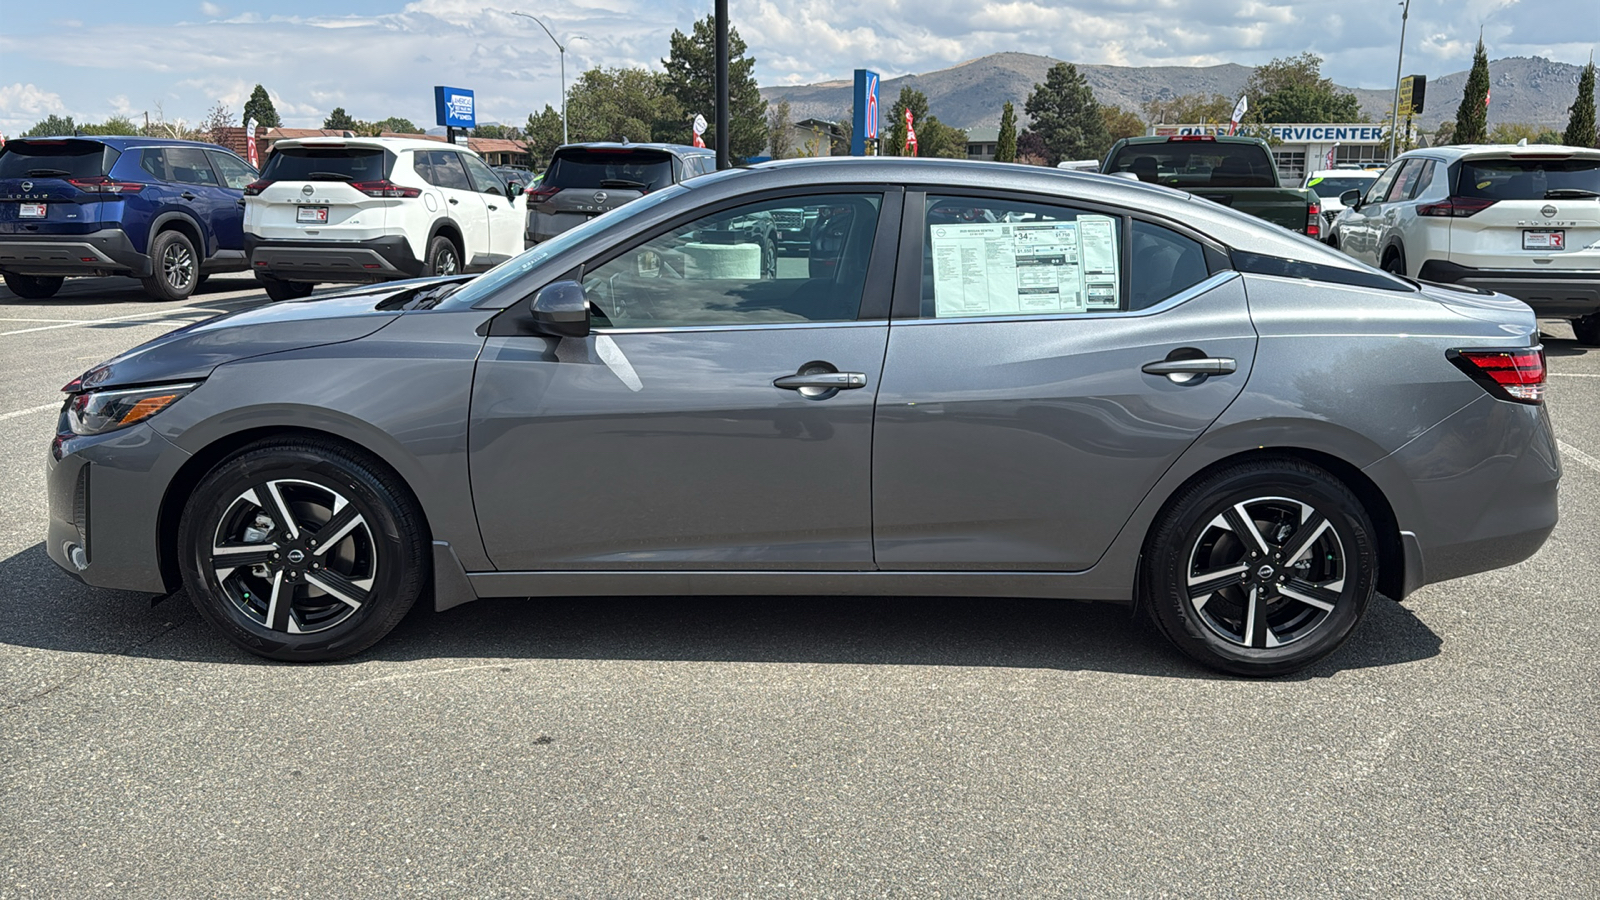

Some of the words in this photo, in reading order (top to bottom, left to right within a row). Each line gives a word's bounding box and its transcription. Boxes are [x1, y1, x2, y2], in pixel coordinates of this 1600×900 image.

[867, 75, 877, 138] 6
[1260, 127, 1383, 140] ERVICENTER
[1018, 232, 1028, 240] 34
